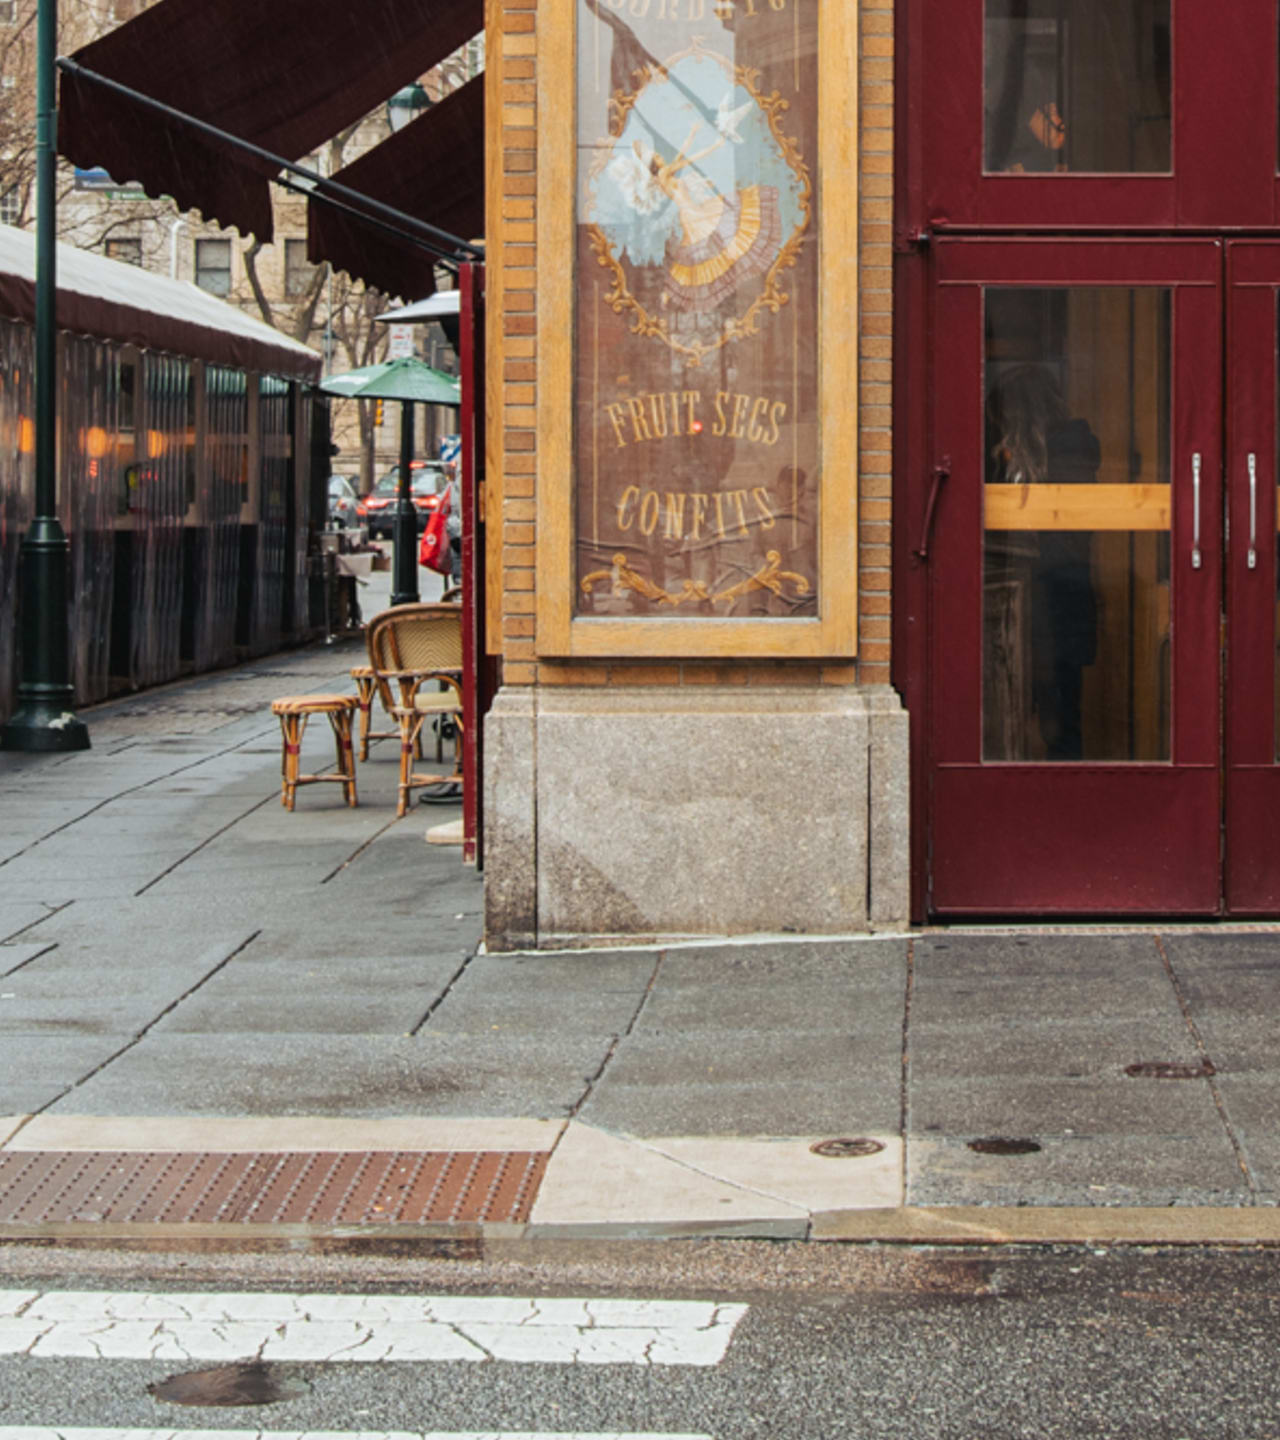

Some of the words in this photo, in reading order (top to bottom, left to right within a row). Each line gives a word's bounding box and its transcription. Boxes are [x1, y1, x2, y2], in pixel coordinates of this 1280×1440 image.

[604, 390, 701, 448] FRUIT
[712, 391, 787, 446] SECS
[617, 484, 776, 541] CONFITS
